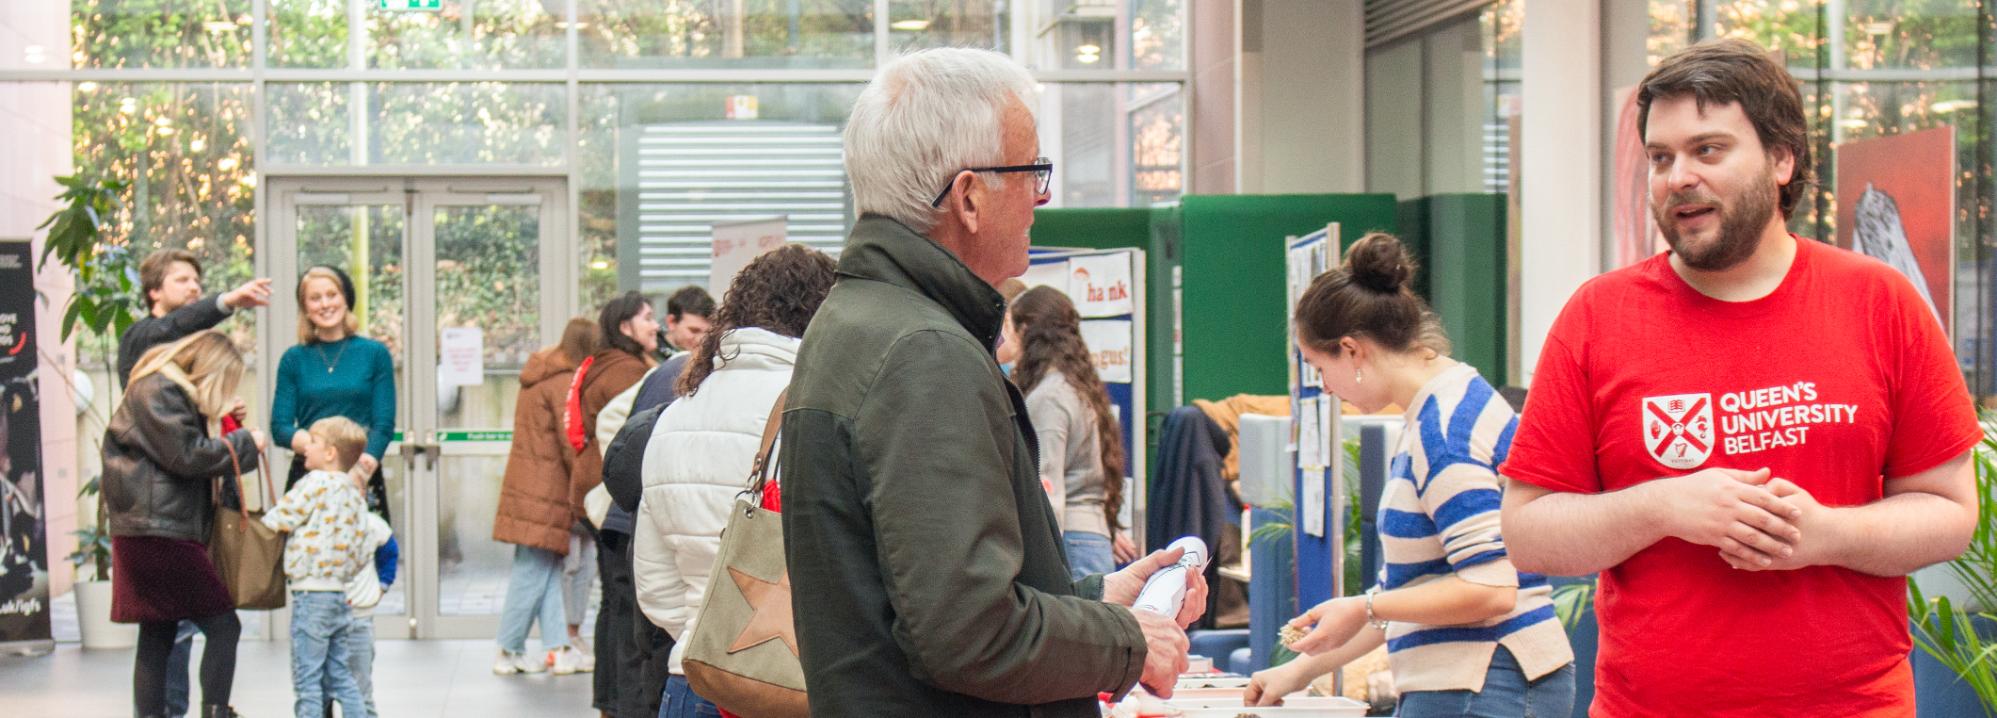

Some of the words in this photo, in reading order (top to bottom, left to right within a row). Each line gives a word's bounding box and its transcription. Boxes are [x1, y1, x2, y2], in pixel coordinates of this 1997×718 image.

[1720, 381, 1818, 413] QUEEN'S
[1721, 403, 1858, 435] UNIVERSITY
[1724, 426, 1809, 455] BELFAST
